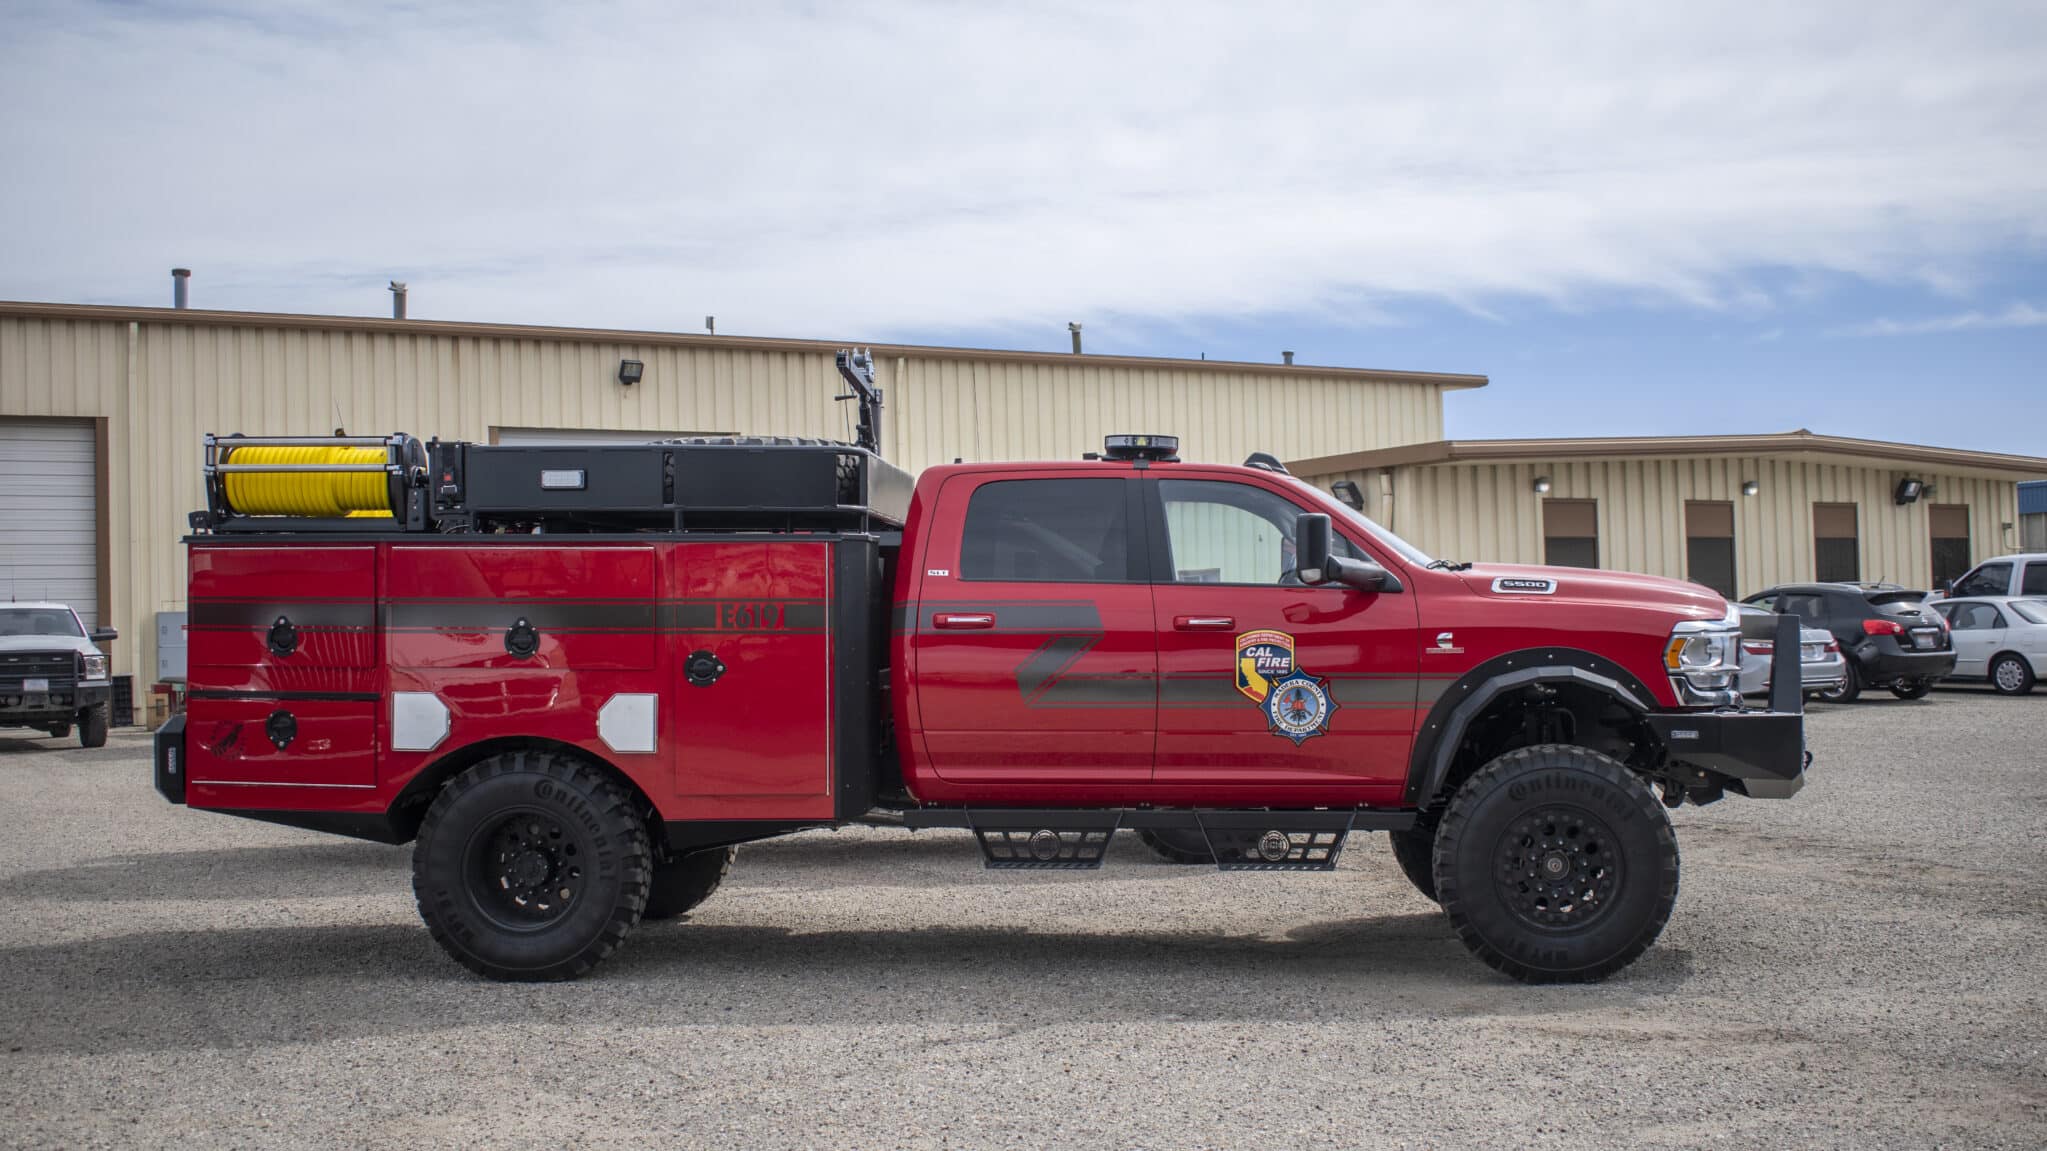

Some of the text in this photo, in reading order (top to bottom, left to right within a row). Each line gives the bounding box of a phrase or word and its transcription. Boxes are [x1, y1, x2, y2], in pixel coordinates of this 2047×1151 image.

[1503, 580, 1546, 588] 5500
[722, 604, 778, 628] E619
[1246, 646, 1273, 657] CAL
[1257, 657, 1290, 668] FIRE
[534, 778, 615, 881] Continental
